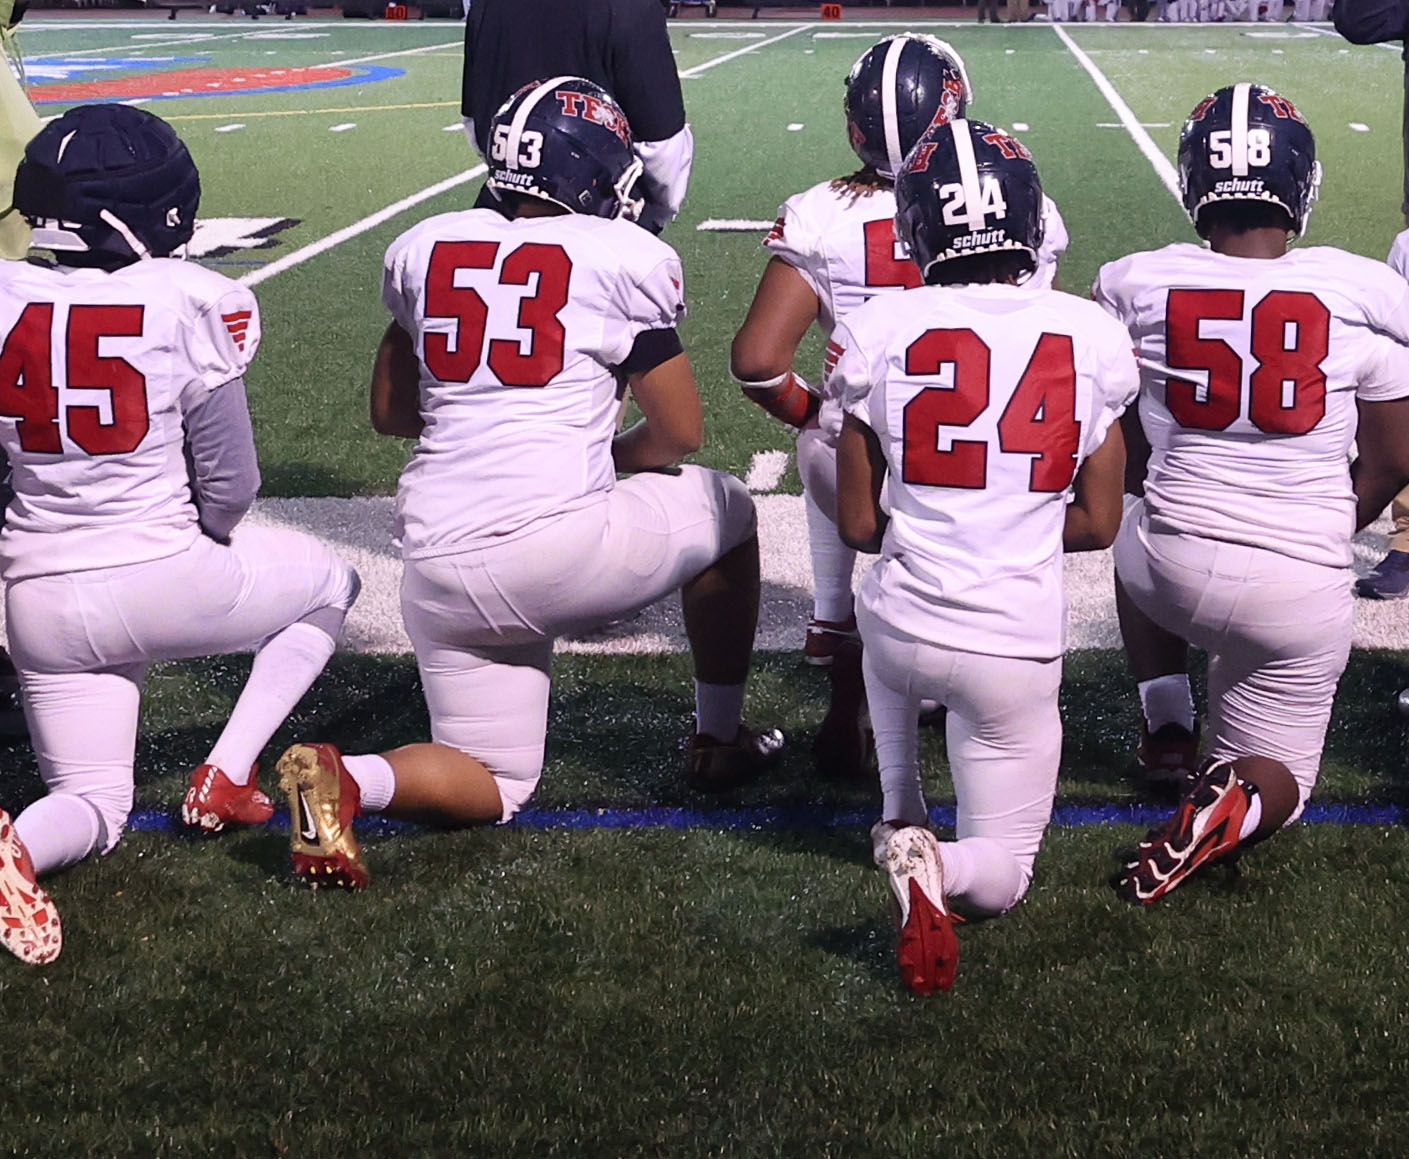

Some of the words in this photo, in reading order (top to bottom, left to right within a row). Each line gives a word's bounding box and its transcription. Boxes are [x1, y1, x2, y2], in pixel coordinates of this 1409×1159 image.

[823, 5, 841, 18] 40
[492, 124, 544, 169] 53
[1209, 128, 1272, 170] 58
[494, 168, 535, 187] schutt
[1214, 177, 1265, 193] schutt
[939, 177, 1008, 226] 24
[952, 228, 1006, 250] schutt
[422, 240, 574, 387] 53
[1164, 288, 1332, 436] 58
[901, 326, 1083, 493] 24
